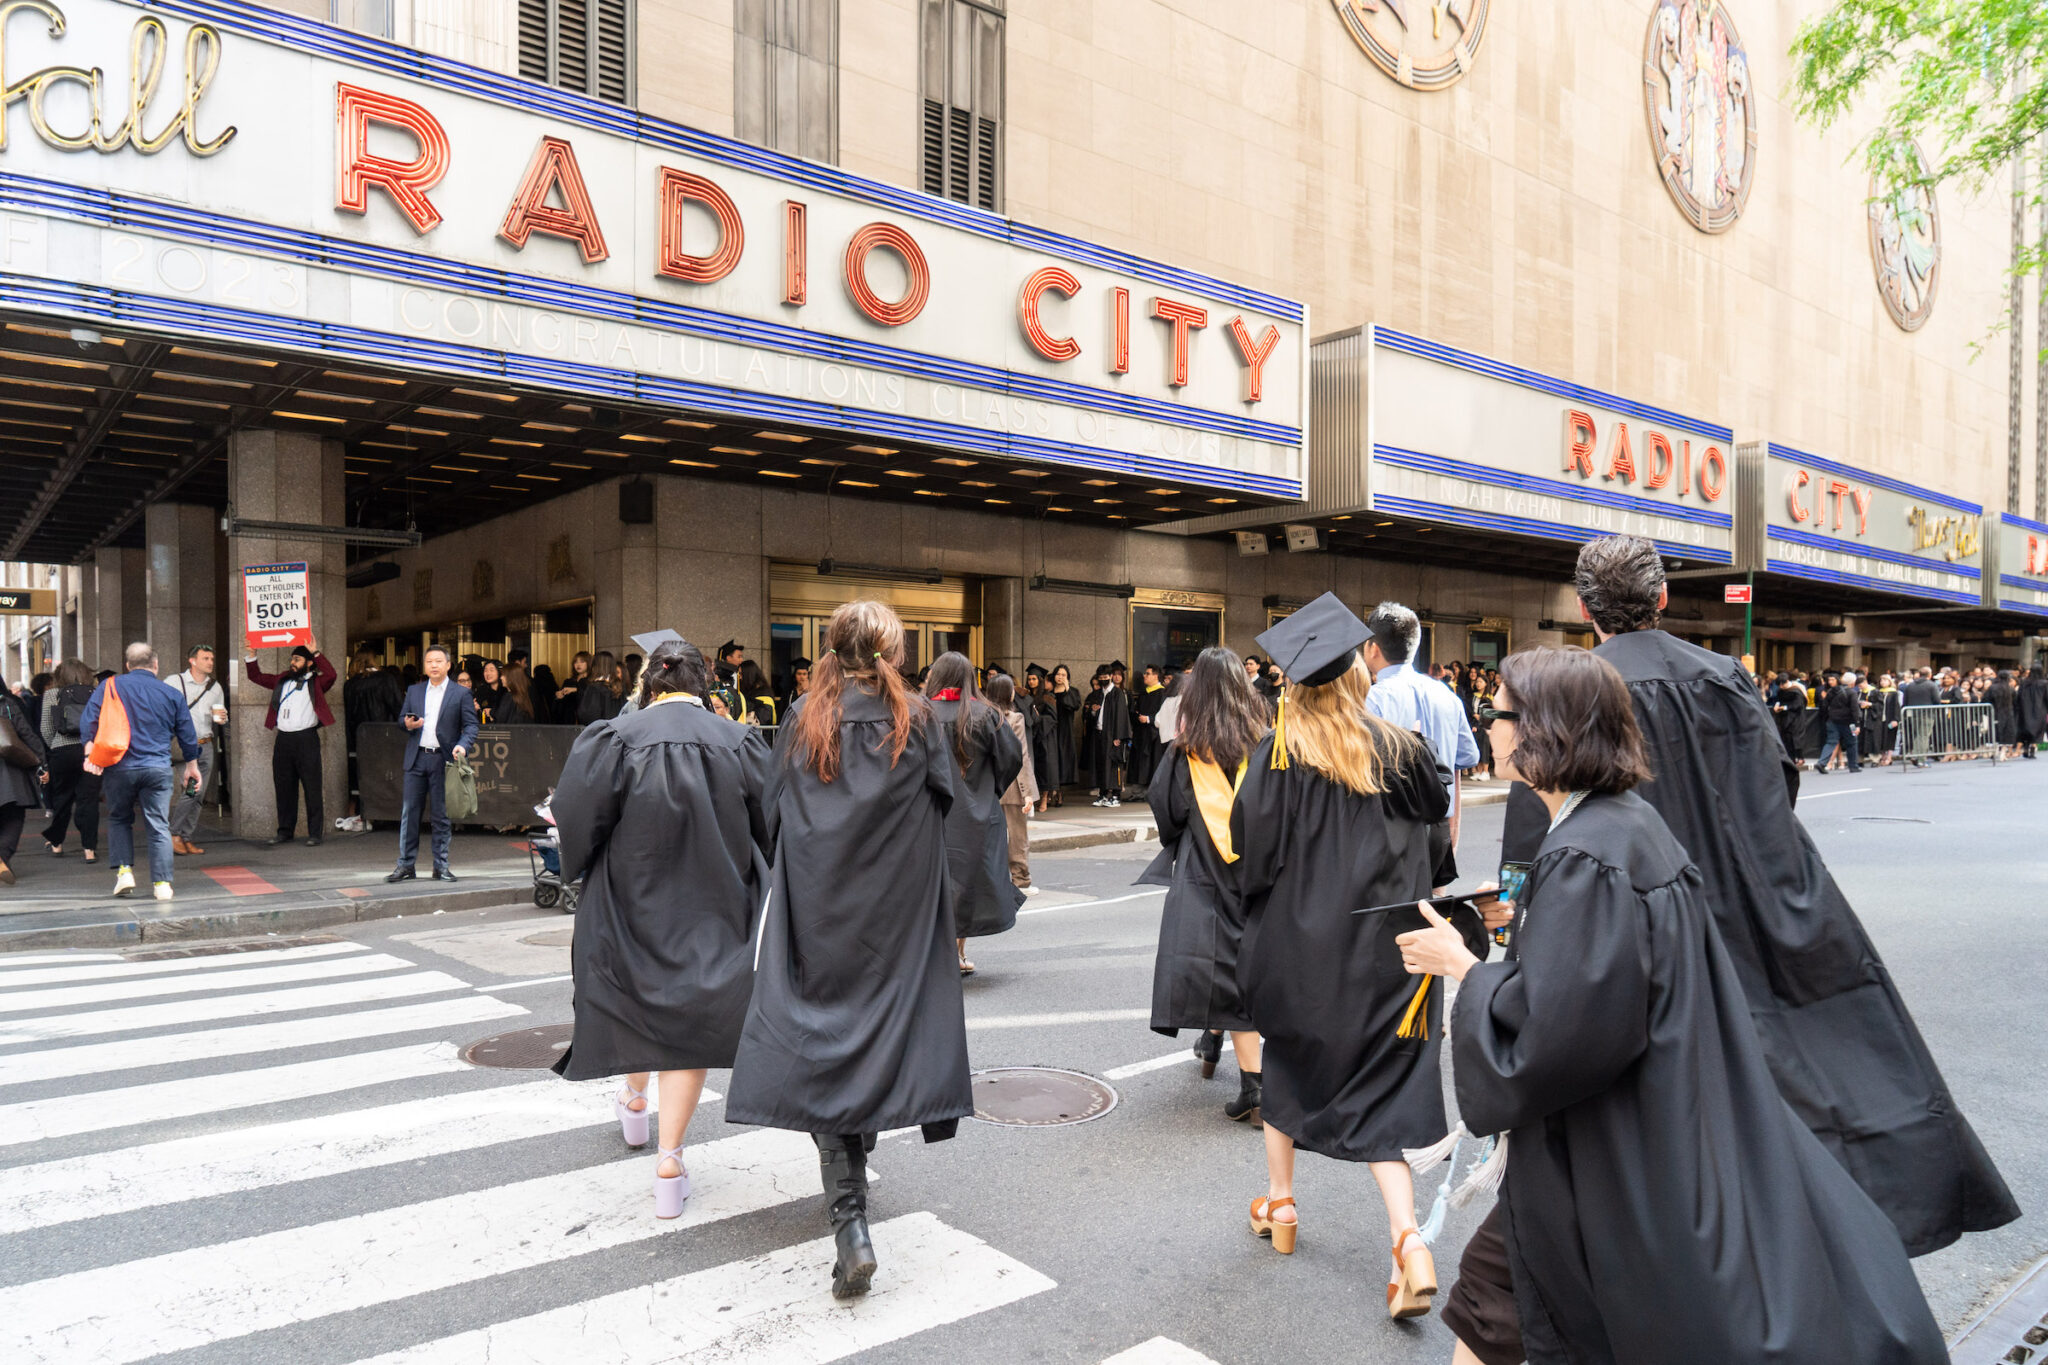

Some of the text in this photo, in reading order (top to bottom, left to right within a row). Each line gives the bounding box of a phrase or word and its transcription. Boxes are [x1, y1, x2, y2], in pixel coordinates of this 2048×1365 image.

[334, 81, 1281, 403] RADIO CITY
[110, 235, 300, 309] 2023
[400, 287, 901, 410] CONGRATULATIONS
[931, 383, 1050, 434] CLASS
[1076, 409, 1118, 444] OF
[1563, 408, 1727, 503] RADIO
[1440, 479, 1493, 509] NOAH
[1504, 490, 1561, 521] KAHAN
[1583, 504, 1612, 530] JUN
[1620, 513, 1629, 532] 7
[1656, 518, 1685, 542] AUG
[1692, 524, 1705, 545] 31
[1788, 470, 1872, 536] CITY
[248, 582, 305, 593] TICKET HOLDERS
[1778, 541, 1828, 567] FONSECA
[1838, 554, 1857, 572] JUN
[1861, 558, 1868, 575] 9
[1877, 561, 1913, 583] CHARLIE
[1916, 568, 1939, 588] PUTH
[256, 601, 299, 619] 50th
[258, 619, 298, 629] Street
[259, 592, 294, 601] ENTER ON
[468, 742, 509, 759] DIO
